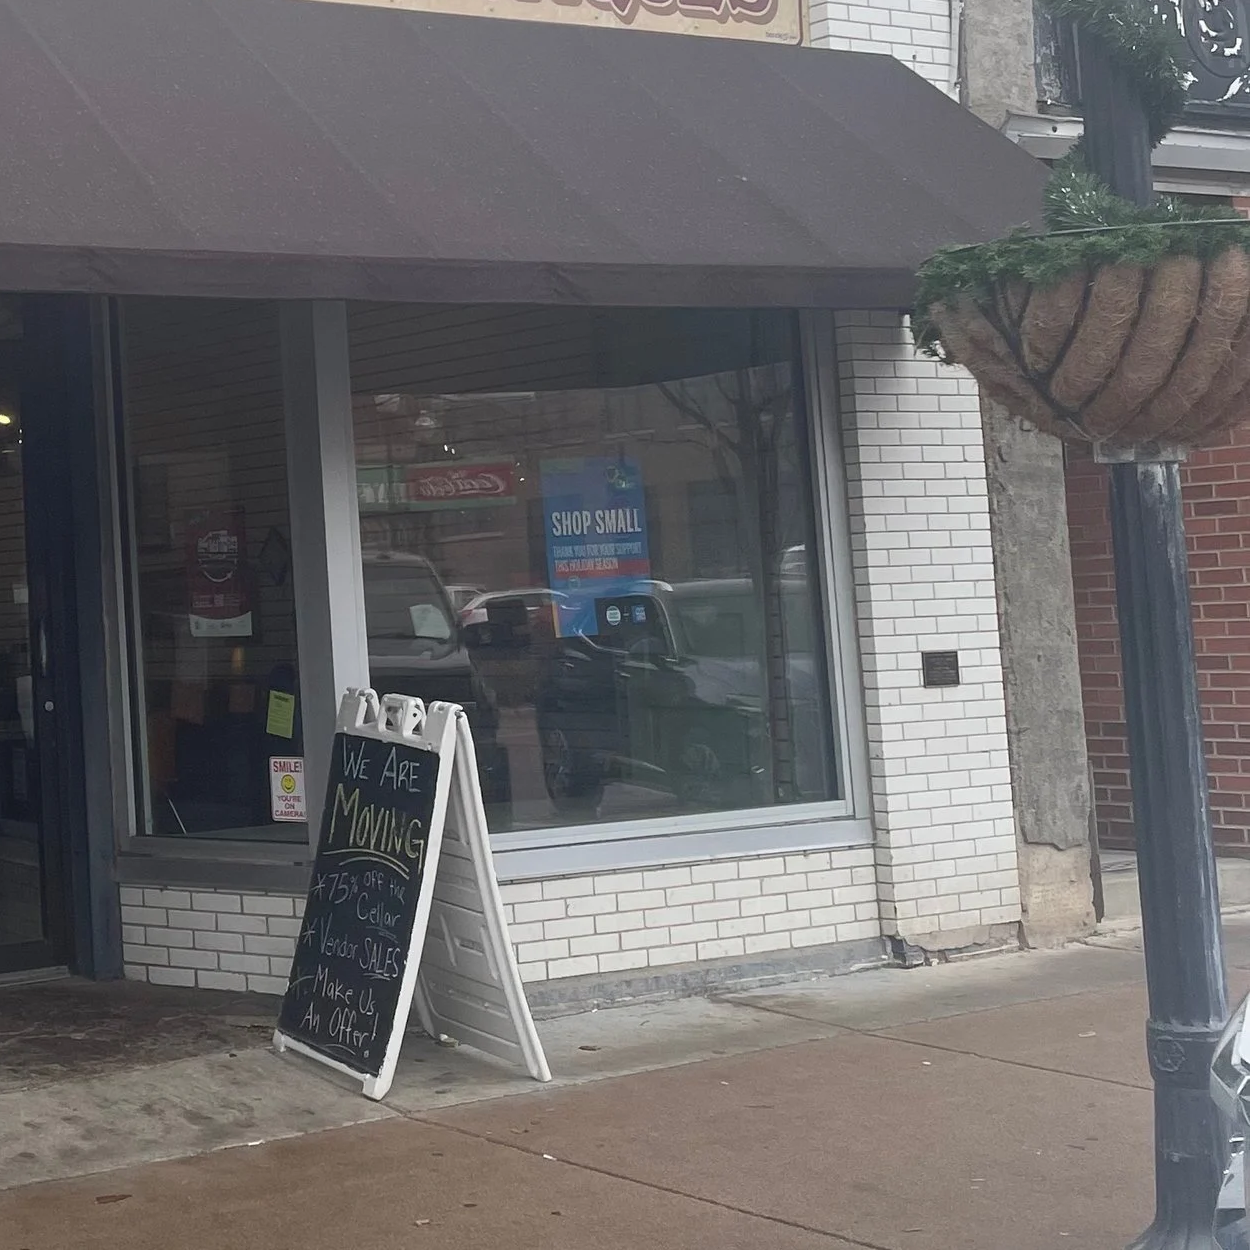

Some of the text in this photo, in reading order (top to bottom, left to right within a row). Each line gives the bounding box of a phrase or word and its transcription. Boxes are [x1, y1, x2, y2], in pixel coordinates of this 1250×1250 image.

[551, 508, 642, 537] SHOP SMALL
[273, 760, 303, 773] SMILE!
[379, 746, 421, 793] ARE
[328, 782, 425, 871] MOVING
[356, 892, 402, 927] Cellar
[390, 879, 406, 905] the
[320, 912, 401, 978] Vendor SALES
[312, 963, 377, 1016] Make Us
[299, 1001, 321, 1034] An
